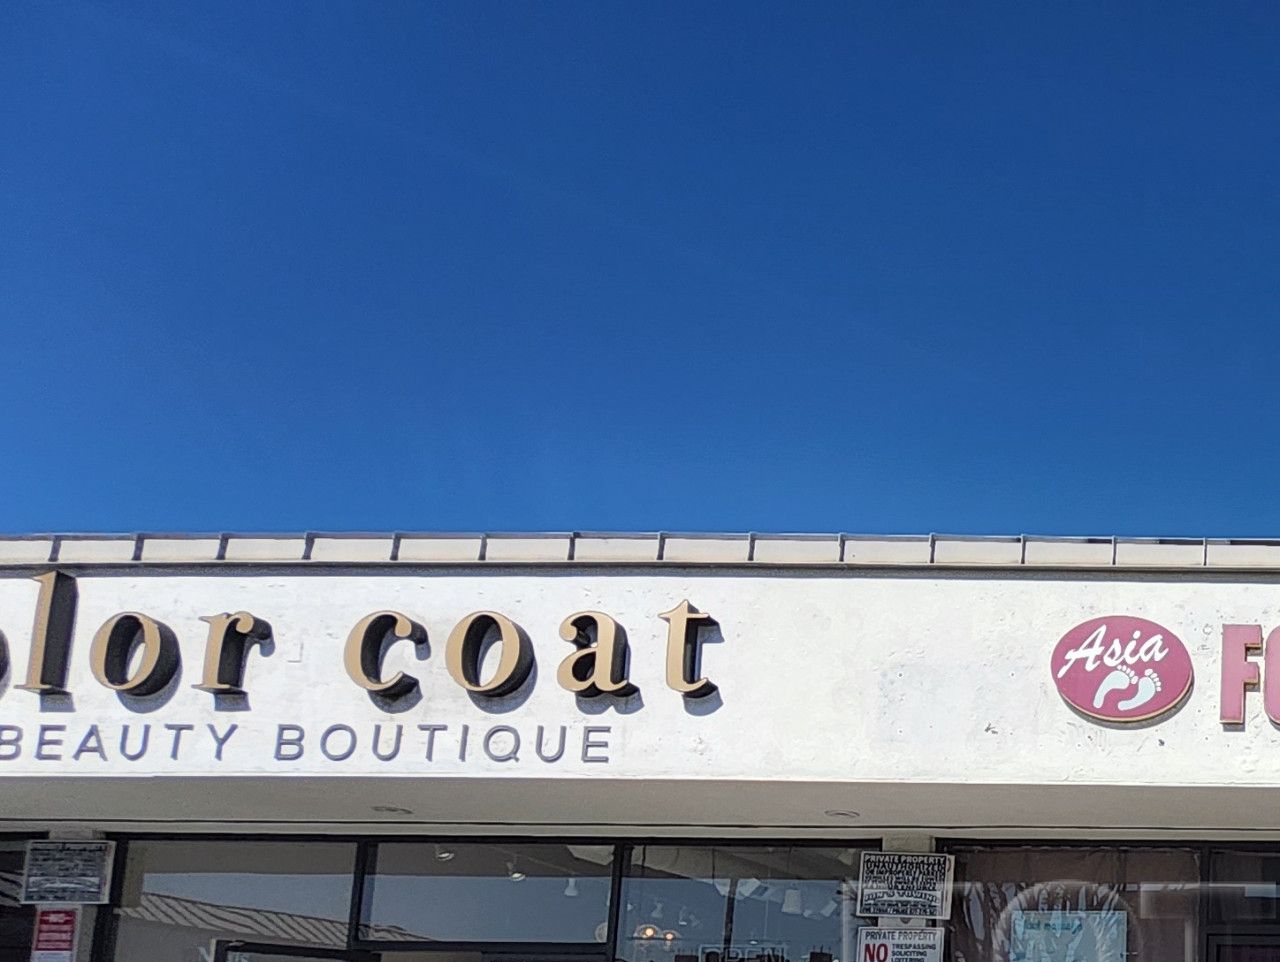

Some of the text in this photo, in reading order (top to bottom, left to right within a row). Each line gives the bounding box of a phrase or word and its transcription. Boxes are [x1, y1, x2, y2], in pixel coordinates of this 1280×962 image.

[344, 598, 724, 714] coat
[1057, 624, 1170, 678] Asia
[0, 724, 612, 763] BEAUTY BOUTIQUE
[864, 855, 945, 864] PRIVATE PROPERTY
[865, 931, 937, 941] PRIVATE PROPERTY
[863, 943, 889, 962] NO
